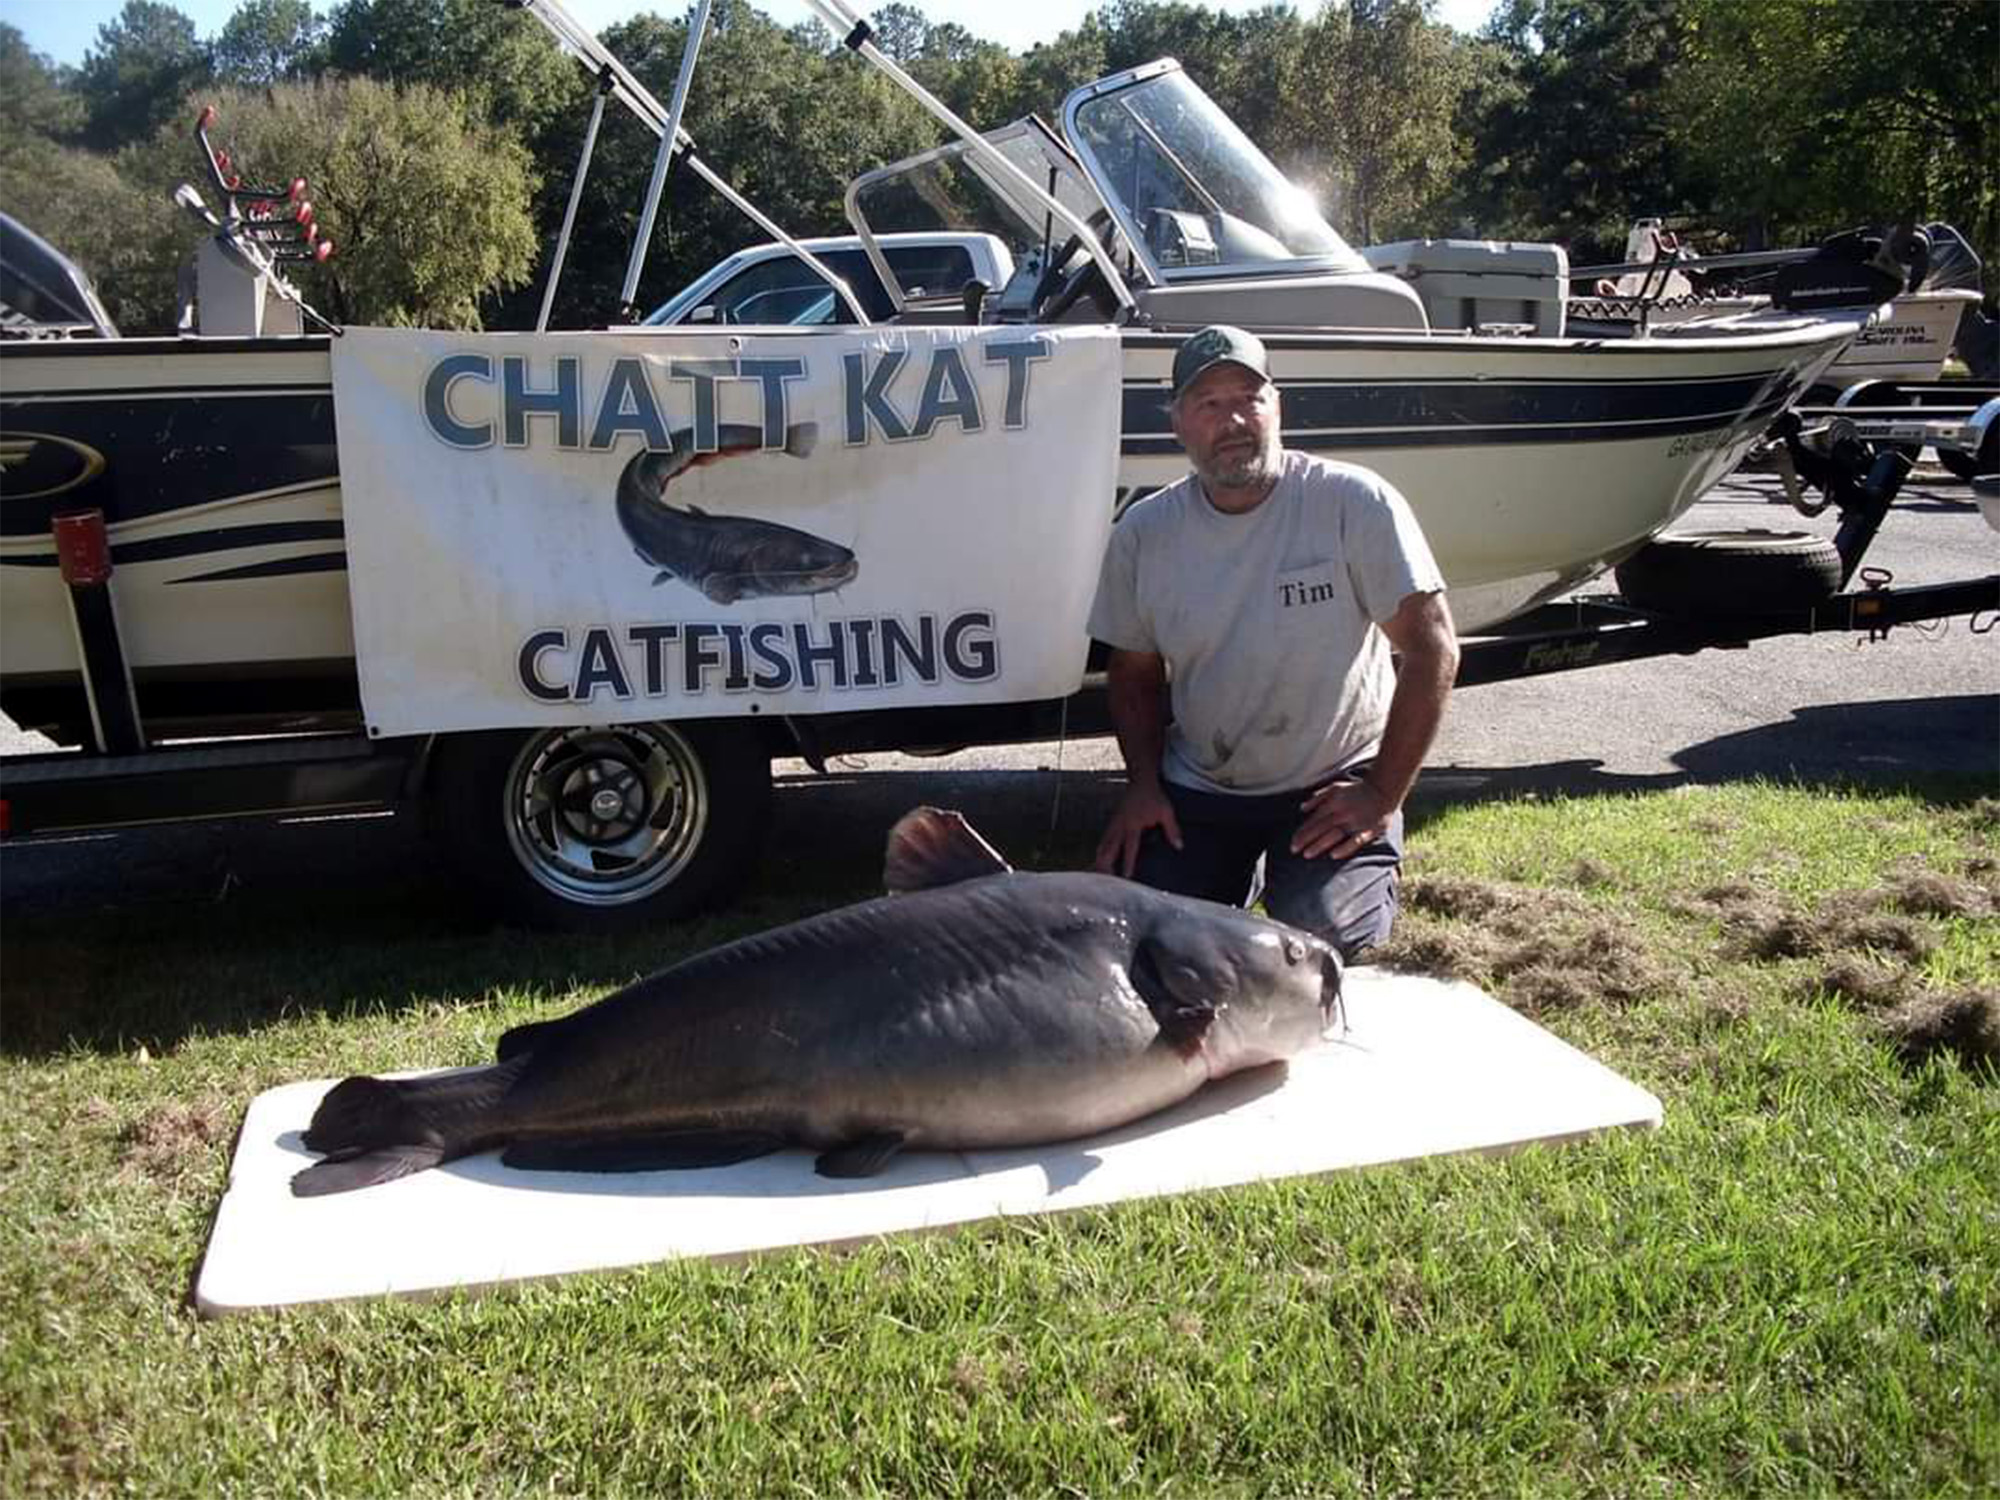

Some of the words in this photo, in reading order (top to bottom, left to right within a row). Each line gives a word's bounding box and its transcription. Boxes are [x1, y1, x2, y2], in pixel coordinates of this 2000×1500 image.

[423, 354, 808, 453] CHATT
[841, 340, 1051, 447] KAT
[1279, 581, 1334, 607] Tim
[517, 609, 999, 703] CATFISHING
